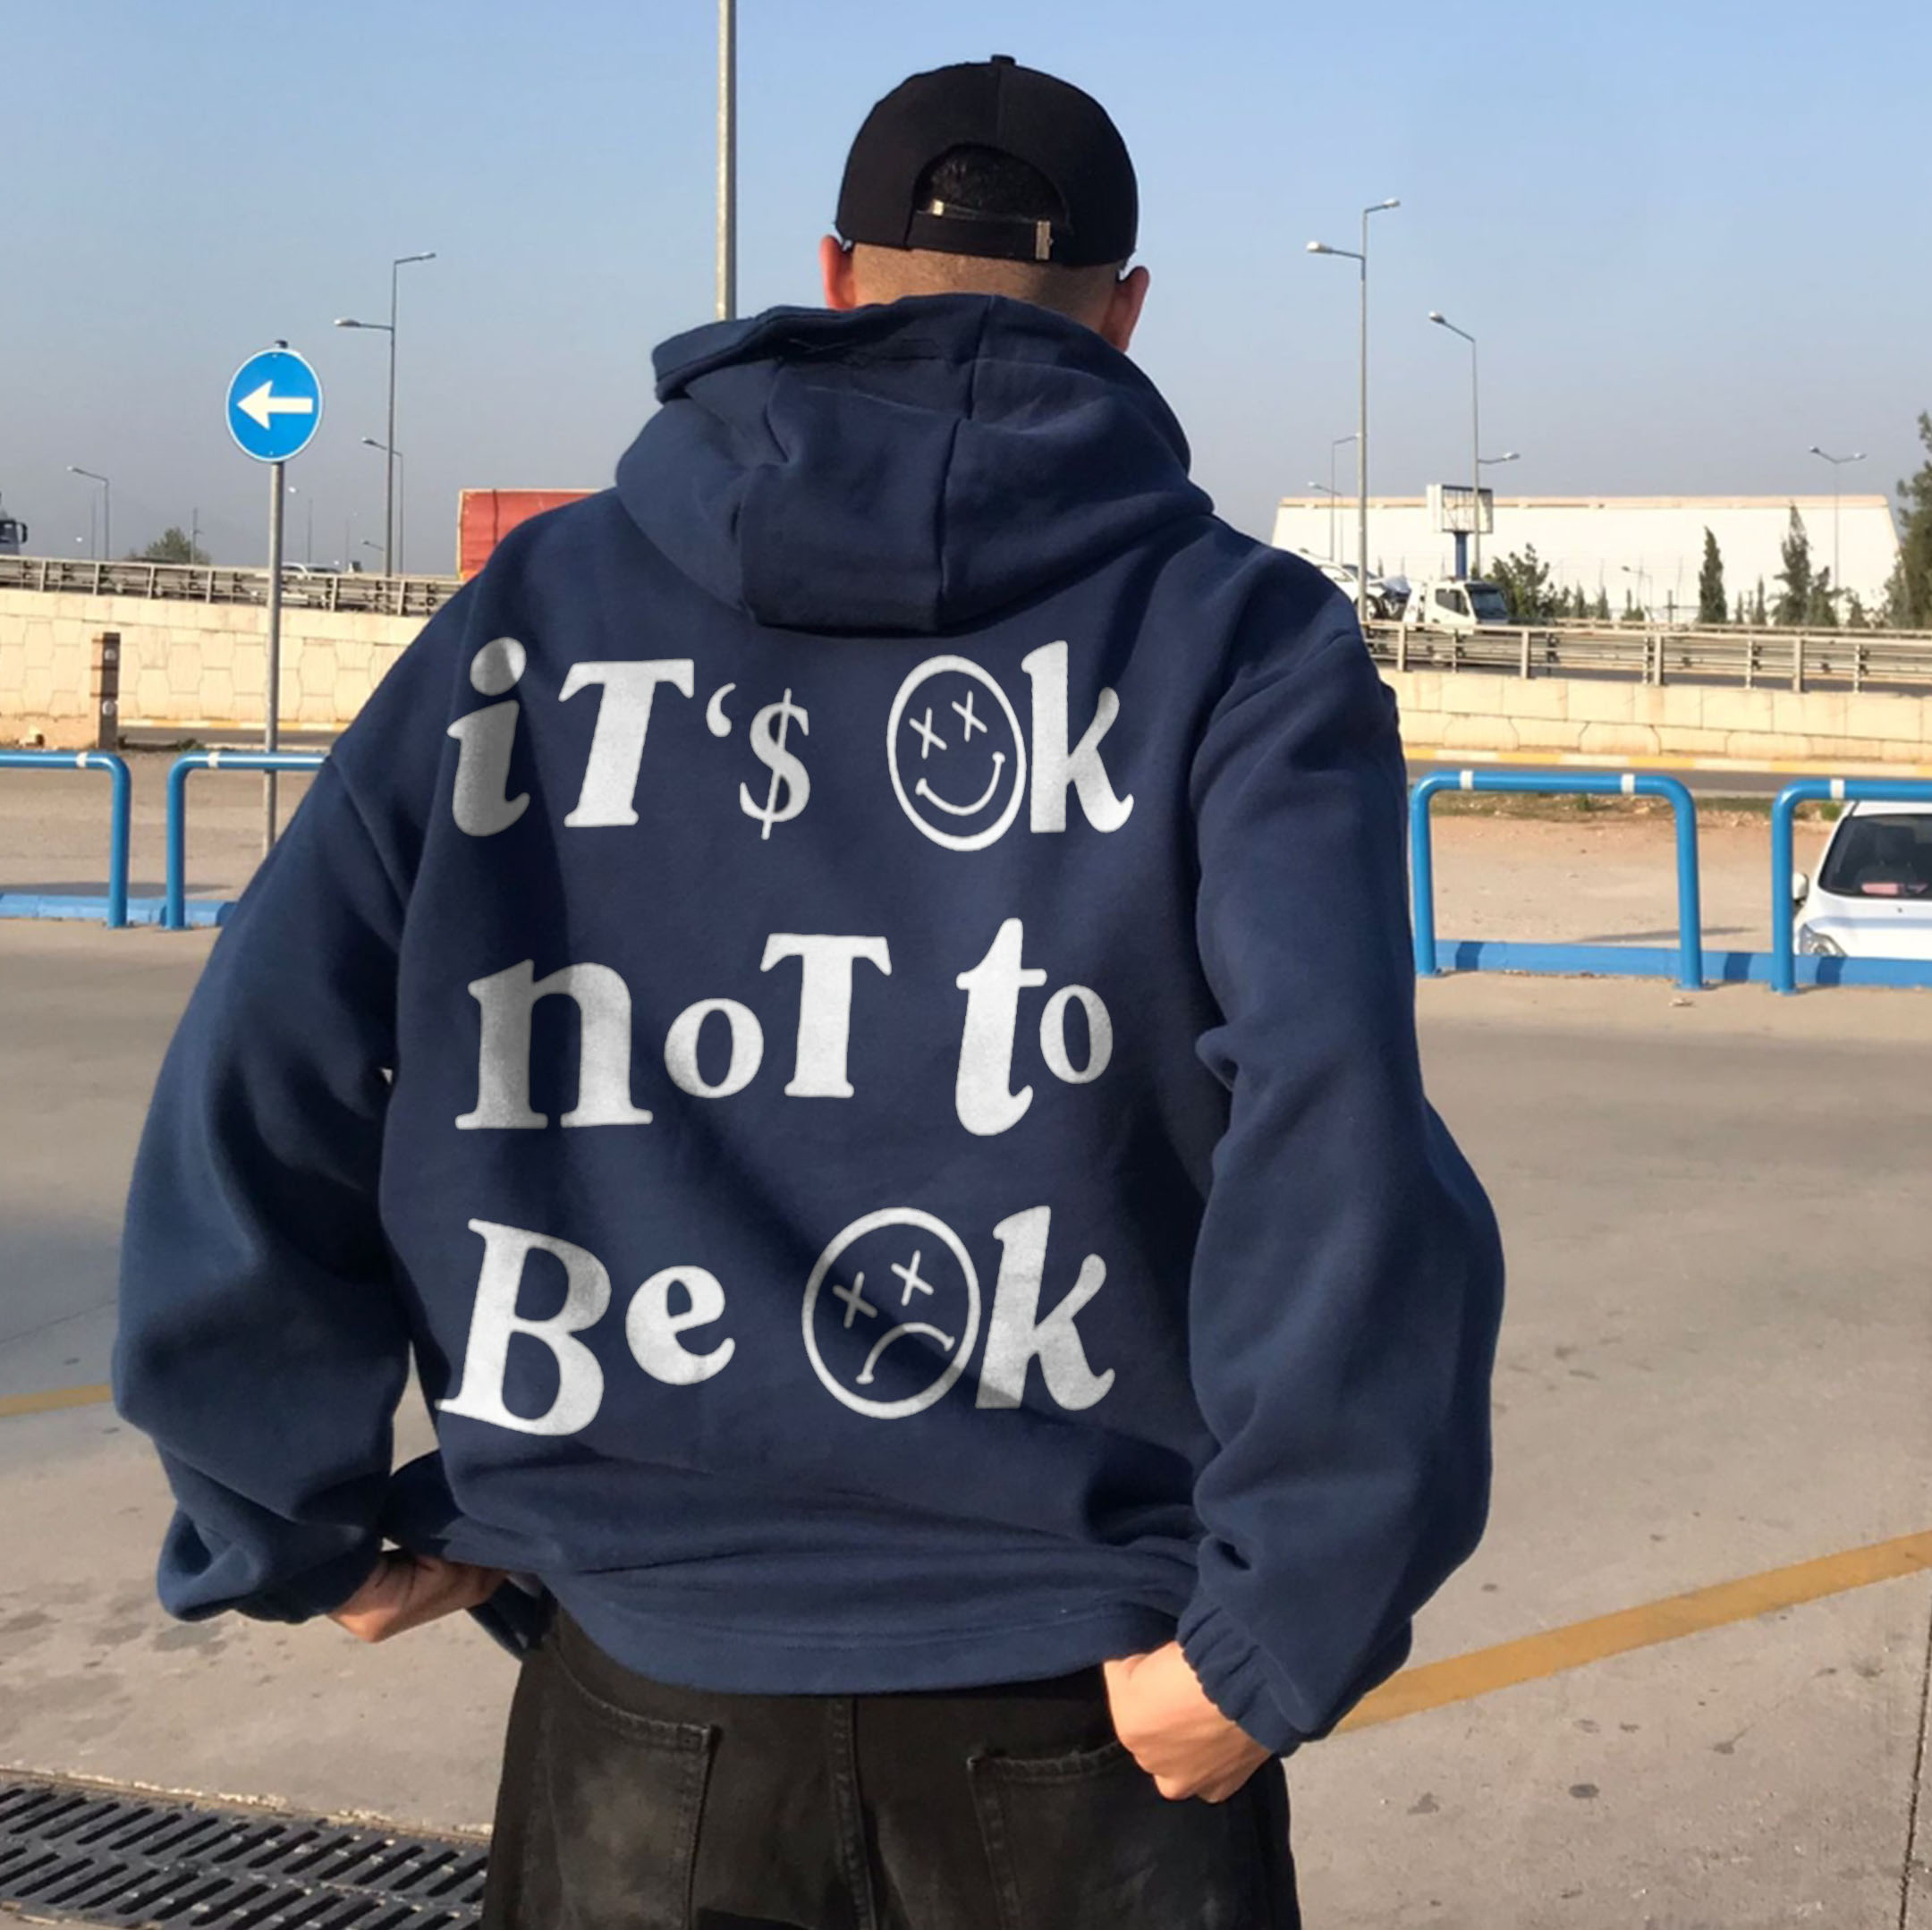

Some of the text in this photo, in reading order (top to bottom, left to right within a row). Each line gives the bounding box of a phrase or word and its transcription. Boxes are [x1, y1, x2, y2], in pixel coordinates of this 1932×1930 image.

[453, 916, 1114, 1137] noT to
[434, 1217, 737, 1437] Be
